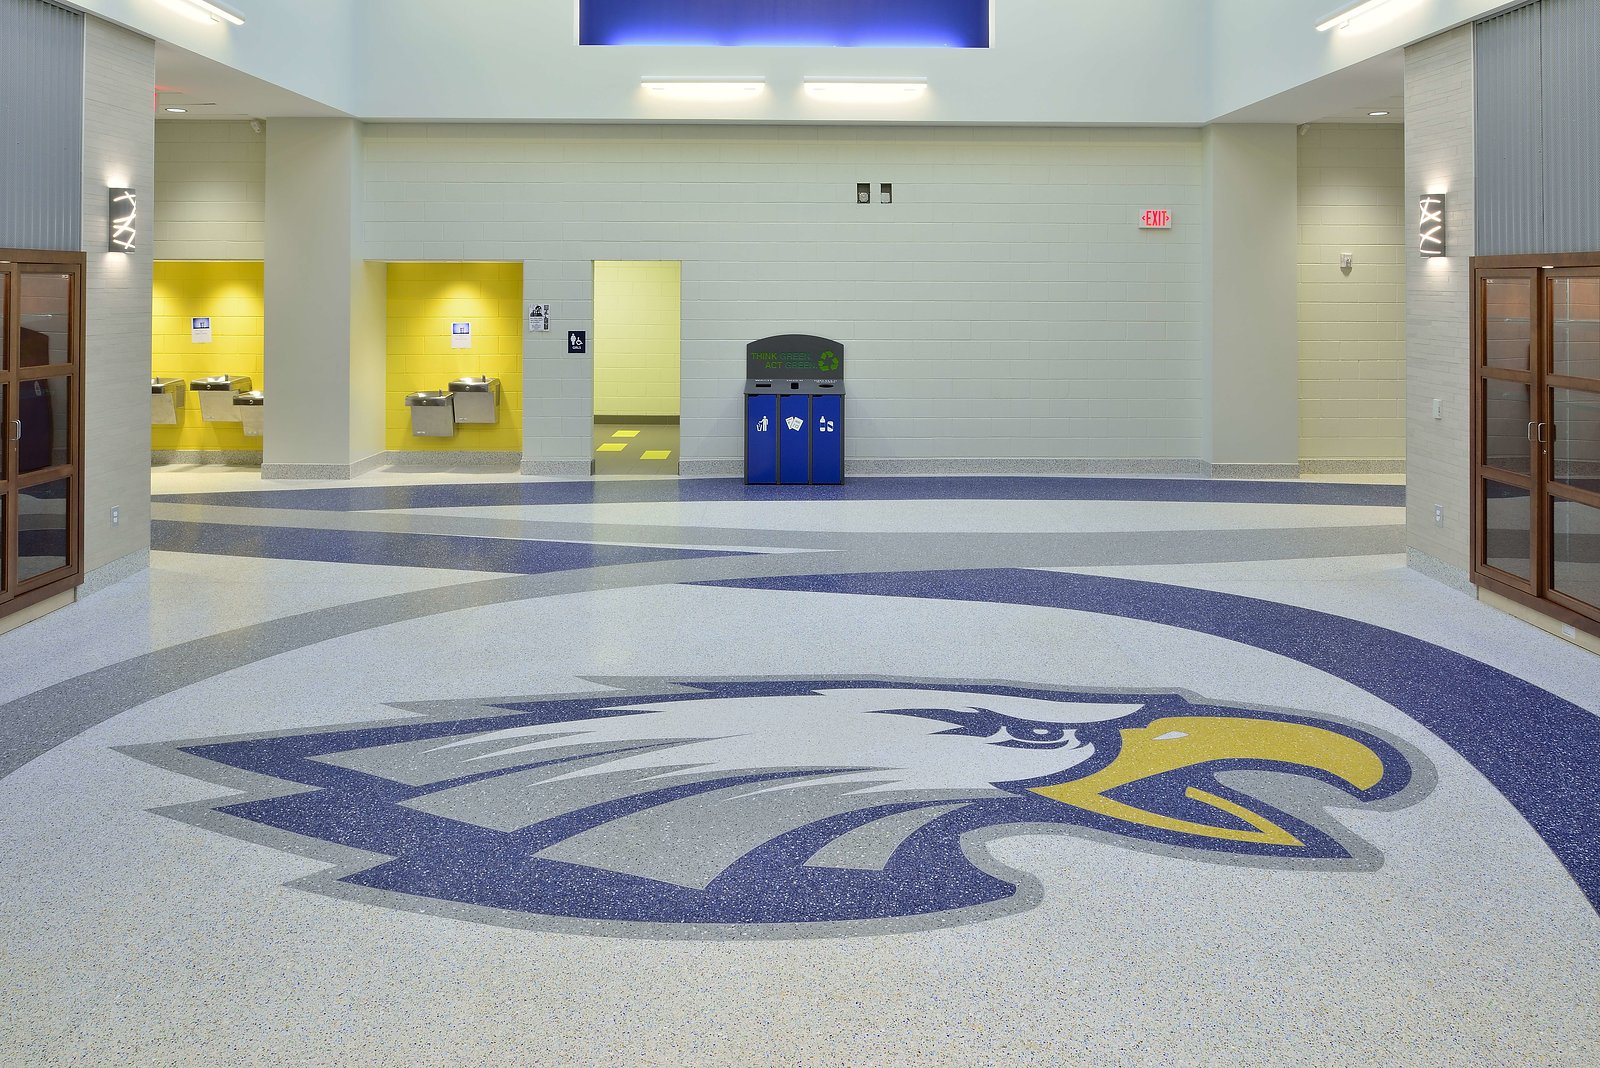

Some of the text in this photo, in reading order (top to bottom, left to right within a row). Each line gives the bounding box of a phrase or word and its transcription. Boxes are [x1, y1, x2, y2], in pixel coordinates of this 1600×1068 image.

[1145, 210, 1167, 226] EXIT
[751, 352, 777, 360] THINK
[765, 361, 783, 369] ACT
